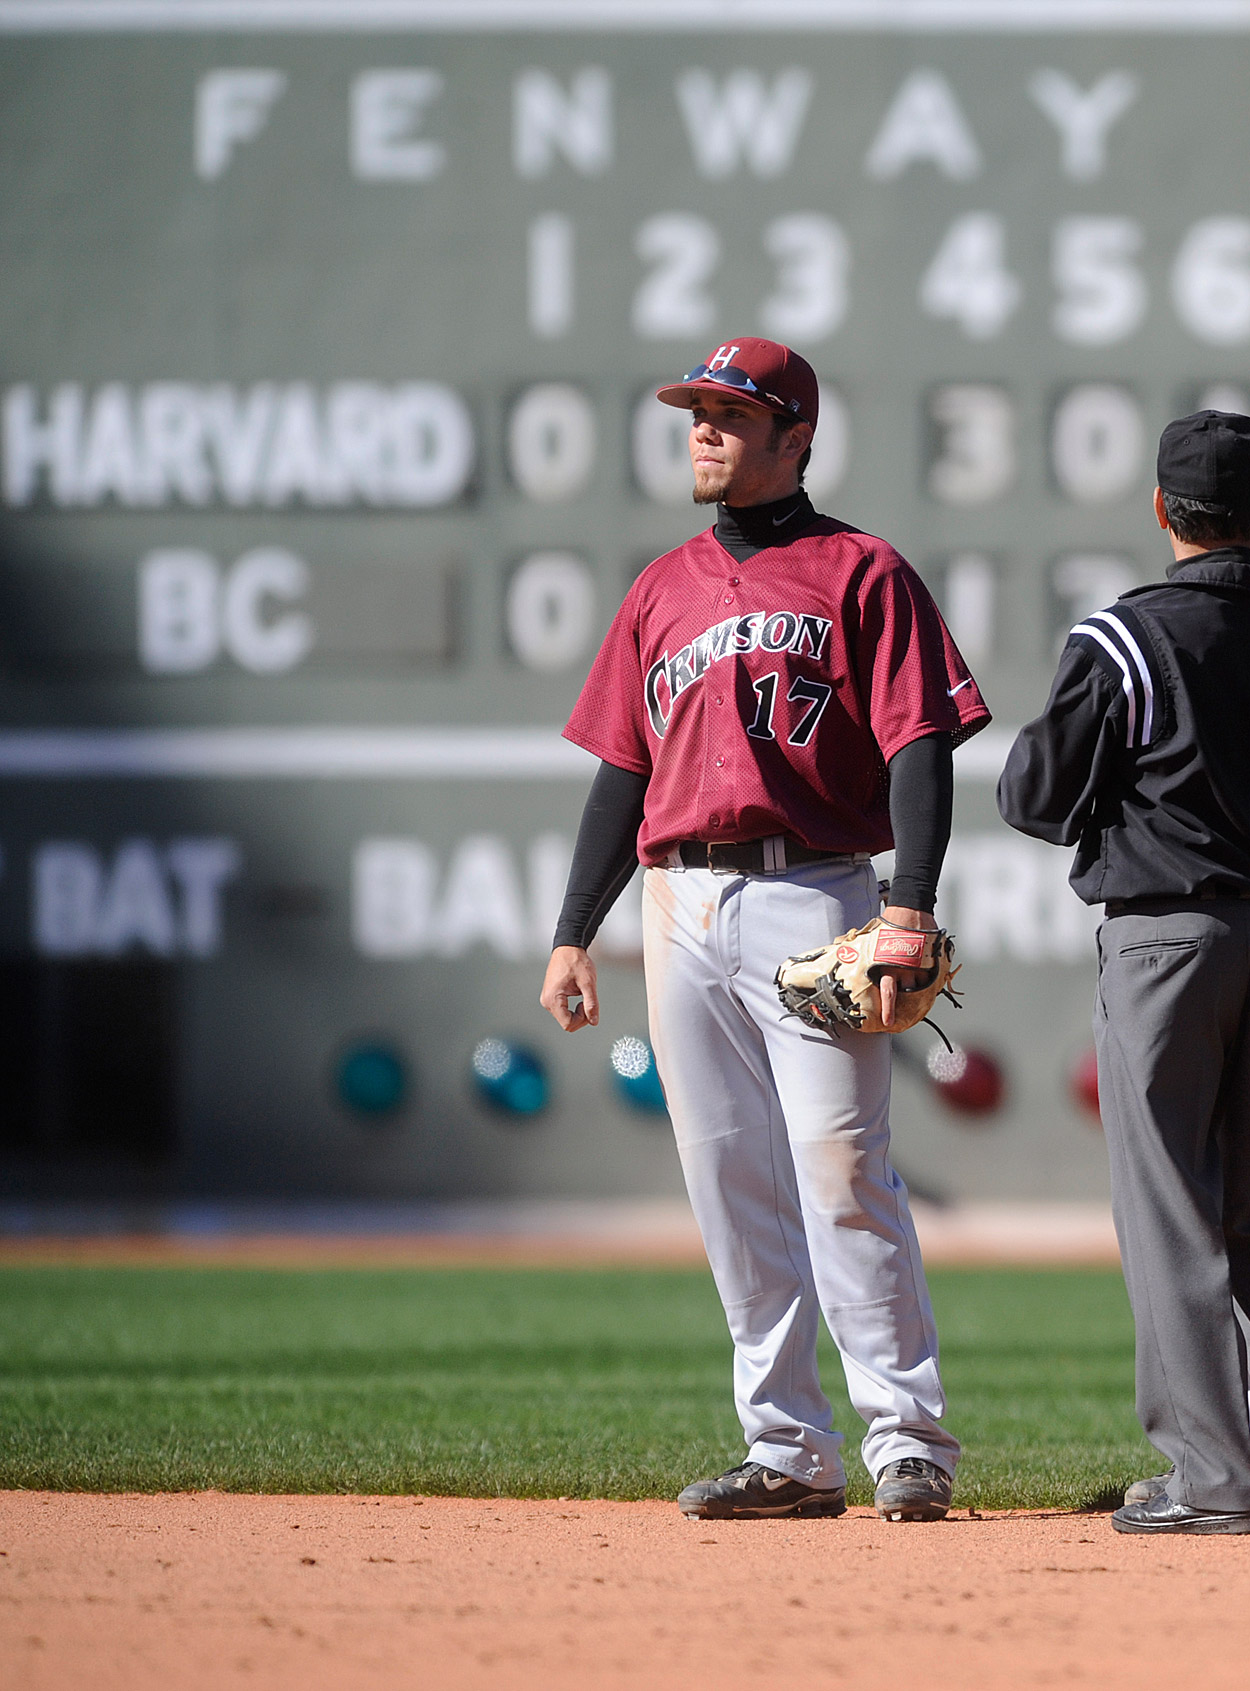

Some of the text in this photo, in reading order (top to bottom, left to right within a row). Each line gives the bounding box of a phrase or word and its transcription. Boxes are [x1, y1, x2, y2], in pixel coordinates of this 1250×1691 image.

[193, 68, 1138, 182] FENWAY
[527, 212, 573, 340] 1
[632, 211, 720, 340] 2
[760, 212, 848, 346] 3
[920, 212, 1020, 342] 4
[1050, 215, 1147, 346] 5
[709, 346, 740, 370] H
[4, 381, 474, 507] HARVARD
[509, 383, 593, 503] 0
[927, 384, 1013, 504] 3
[1052, 383, 1146, 504] 0
[137, 547, 312, 676] BC
[508, 550, 594, 672] 0
[645, 611, 833, 740] CRIMSON
[747, 672, 832, 747] 17
[32, 838, 242, 958] BAT
